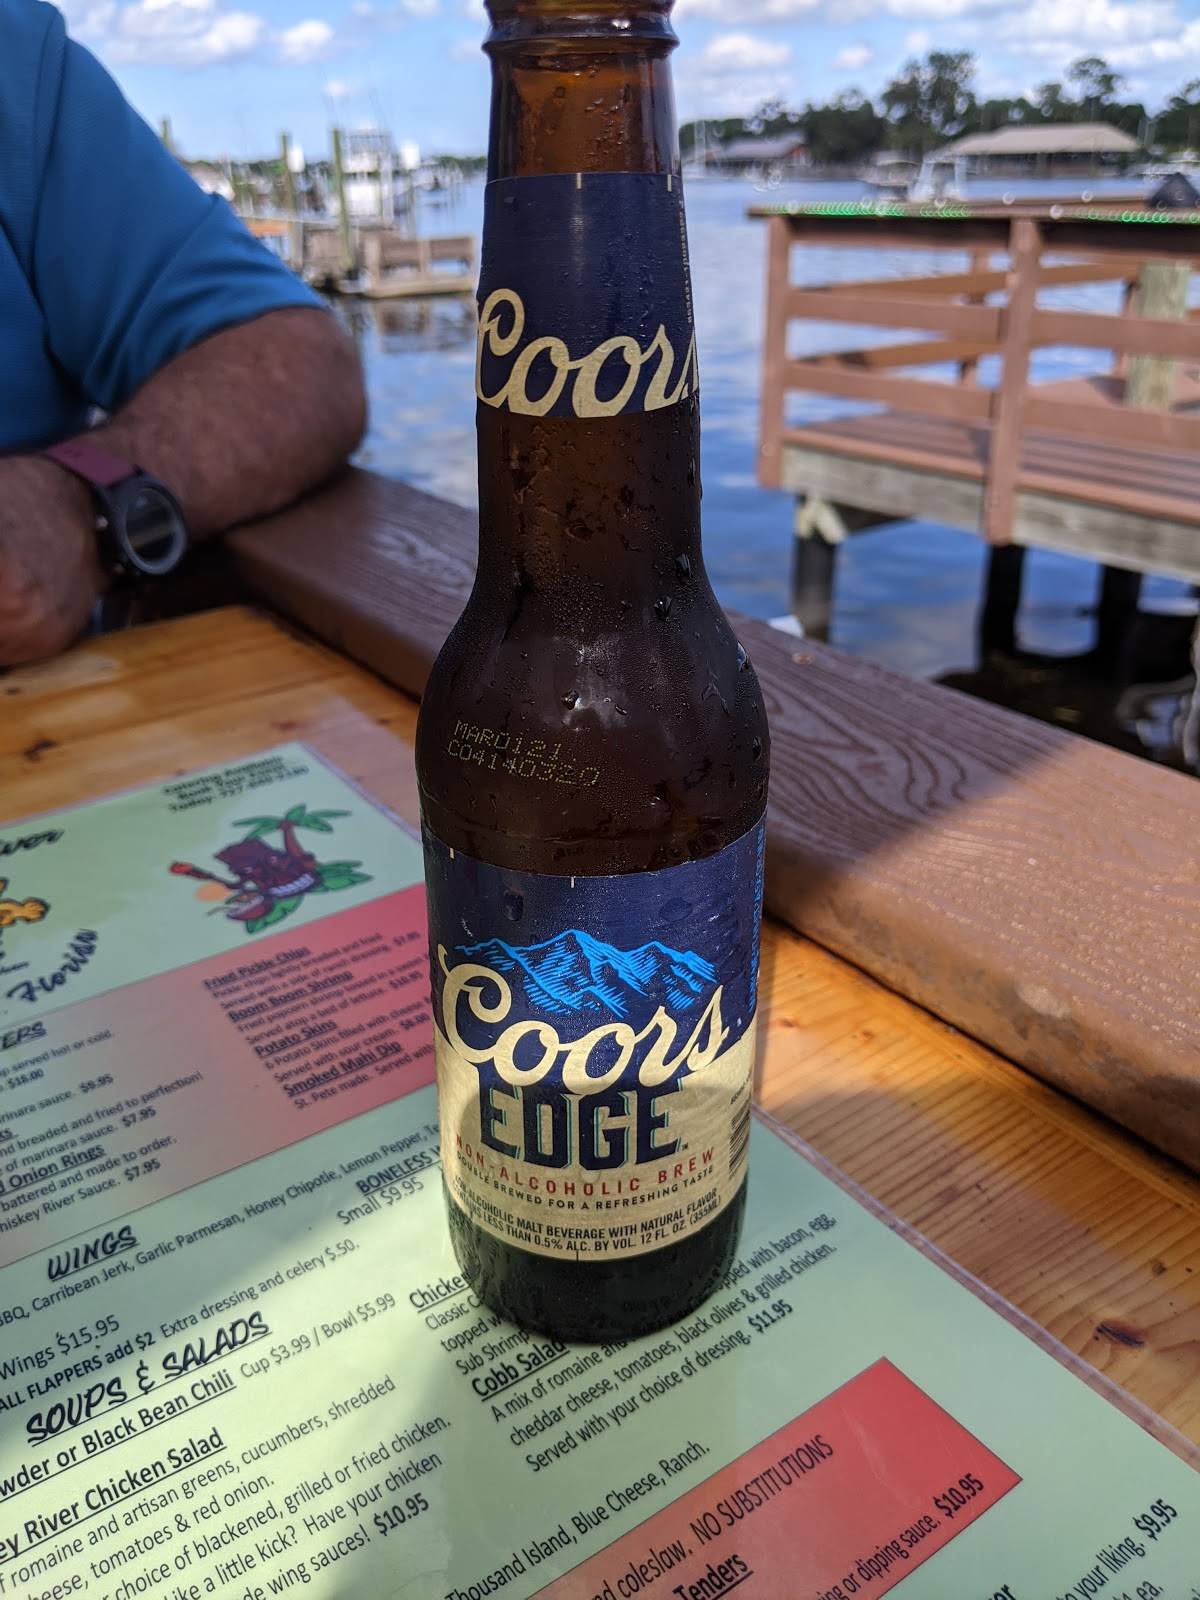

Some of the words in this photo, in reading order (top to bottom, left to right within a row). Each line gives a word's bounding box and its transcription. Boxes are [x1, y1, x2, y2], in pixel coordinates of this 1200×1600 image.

[437, 943, 731, 1095] Coors
[8, 1162, 59, 1187] Onion
[60, 1144, 105, 1167] Rings
[456, 1134, 641, 1196] NON-ALCOHOLIC
[657, 1146, 715, 1185] BREW
[480, 1078, 683, 1171] EDGE
[41, 1193, 75, 1214] River
[76, 1178, 120, 1199] Sauce.
[123, 1157, 160, 1181] $7.95
[336, 1194, 381, 1225] Small
[379, 1176, 424, 1205] $9.95
[355, 1150, 434, 1196] BONELESS
[456, 1150, 490, 1184] DOUBLE
[493, 1182, 542, 1205] BREWED
[548, 1198, 575, 1210] FOR
[580, 1202, 590, 1210] A
[595, 1184, 679, 1210] REFRESHING
[682, 1167, 714, 1188] TASTE
[516, 1217, 544, 1234] MALT
[546, 1224, 605, 1239] BEVERAGE
[608, 1223, 637, 1239] WITH
[640, 1208, 685, 1233] NATURAL
[686, 1187, 717, 1215] FLAVOR
[31, 1275, 100, 1311] Carribean
[101, 1259, 135, 1281] Jerk,
[134, 1241, 176, 1264] Garlic
[174, 1214, 245, 1247] Parmesan,
[243, 1193, 286, 1217] Honey
[285, 1170, 342, 1199] Chipotle,
[339, 1151, 382, 1174] Lemon
[379, 1132, 421, 1156] Pepper,
[48, 1224, 138, 1280] WINGS
[505, 1224, 532, 1243] THAN
[534, 1234, 563, 1250] 0.5%
[566, 1240, 591, 1251] ALC.
[594, 1240, 609, 1251] BY
[640, 1232, 652, 1244] 12
[746, 1248, 776, 1269] with
[770, 1228, 814, 1254] bacon,
[0, 1390, 26, 1414] ALL
[26, 1354, 102, 1399] FLAPPERS
[104, 1339, 134, 1363] add
[134, 1331, 156, 1351] $2
[159, 1314, 198, 1338] Extra
[199, 1286, 258, 1319] dressing
[257, 1271, 284, 1292] and
[285, 1254, 325, 1279] celery
[56, 1314, 119, 1356] $15.95
[424, 1302, 469, 1330] Classic
[439, 1317, 489, 1352] topped
[509, 1405, 565, 1446] cheddar
[565, 1378, 618, 1412] cheese,
[612, 1340, 681, 1382] tomatoes,
[673, 1316, 713, 1345] black
[709, 1297, 746, 1324] olives
[740, 1288, 759, 1303] &
[754, 1265, 793, 1299] grilled
[789, 1244, 836, 1274] chicken.
[26, 1375, 128, 1444] SOUPS
[136, 1359, 156, 1395] &
[162, 1311, 271, 1380] SALADS
[56, 1445, 76, 1467] or
[80, 1418, 137, 1454] Black
[137, 1394, 189, 1427] Bean
[190, 1371, 233, 1400] Chili
[240, 1358, 269, 1377] Cup
[270, 1334, 310, 1364] $3.99
[321, 1311, 356, 1337] Bowl
[356, 1293, 394, 1320] $5.99
[455, 1351, 484, 1375] Sub
[471, 1362, 519, 1396] Cobb
[490, 1405, 506, 1422] A
[503, 1391, 533, 1414] mix
[530, 1377, 548, 1398] of
[546, 1351, 602, 1390] romaine
[525, 1430, 578, 1472] Served
[575, 1413, 610, 1441] with
[606, 1395, 639, 1426] your
[638, 1371, 683, 1403] choice
[680, 1356, 697, 1377] of
[694, 1329, 751, 1367] dressing.
[747, 1298, 793, 1334] $11.95
[10, 1538, 84, 1587] romaine
[87, 1515, 120, 1545] and
[122, 1488, 179, 1526] artisan
[181, 1460, 239, 1499] greens,
[241, 1415, 328, 1464] cucumbers,
[327, 1374, 395, 1420] shredded
[23, 1501, 79, 1543] River
[84, 1460, 166, 1510] Chicken
[166, 1426, 223, 1468] Salad
[89, 1525, 172, 1578] tomatoes
[174, 1513, 191, 1532] &
[192, 1495, 221, 1524] red
[223, 1475, 274, 1506] onion.
[115, 1563, 171, 1600] choice
[174, 1544, 192, 1570] of
[192, 1500, 283, 1559] blackened,
[283, 1471, 333, 1514] grilled
[334, 1465, 351, 1483] or
[351, 1441, 390, 1473] fried
[391, 1417, 450, 1452] chicken.
[203, 1576, 216, 1592] a
[214, 1553, 256, 1585] little
[254, 1524, 298, 1562] kick?
[301, 1505, 346, 1535] Have
[345, 1483, 382, 1516] your
[384, 1454, 442, 1491] chicken
[521, 1524, 577, 1566] Island,
[570, 1505, 609, 1534] Blue
[605, 1472, 666, 1512] Cheese,
[658, 1440, 710, 1477] Ranch.
[616, 1539, 693, 1600] coleslaw.
[689, 1512, 721, 1545] NO
[716, 1434, 833, 1526] SUBSTITUTIONS
[266, 1562, 311, 1594] wing
[309, 1523, 370, 1571] sauces!
[373, 1492, 428, 1536] $10.95
[672, 1553, 749, 1600] Tenders
[841, 1572, 861, 1593] or
[854, 1539, 907, 1581] dipping
[898, 1515, 941, 1548] sauce.
[933, 1472, 984, 1519] $10.95
[1073, 1564, 1109, 1600] your
[1095, 1536, 1145, 1573] liking.
[1132, 1498, 1177, 1540] $9.95
